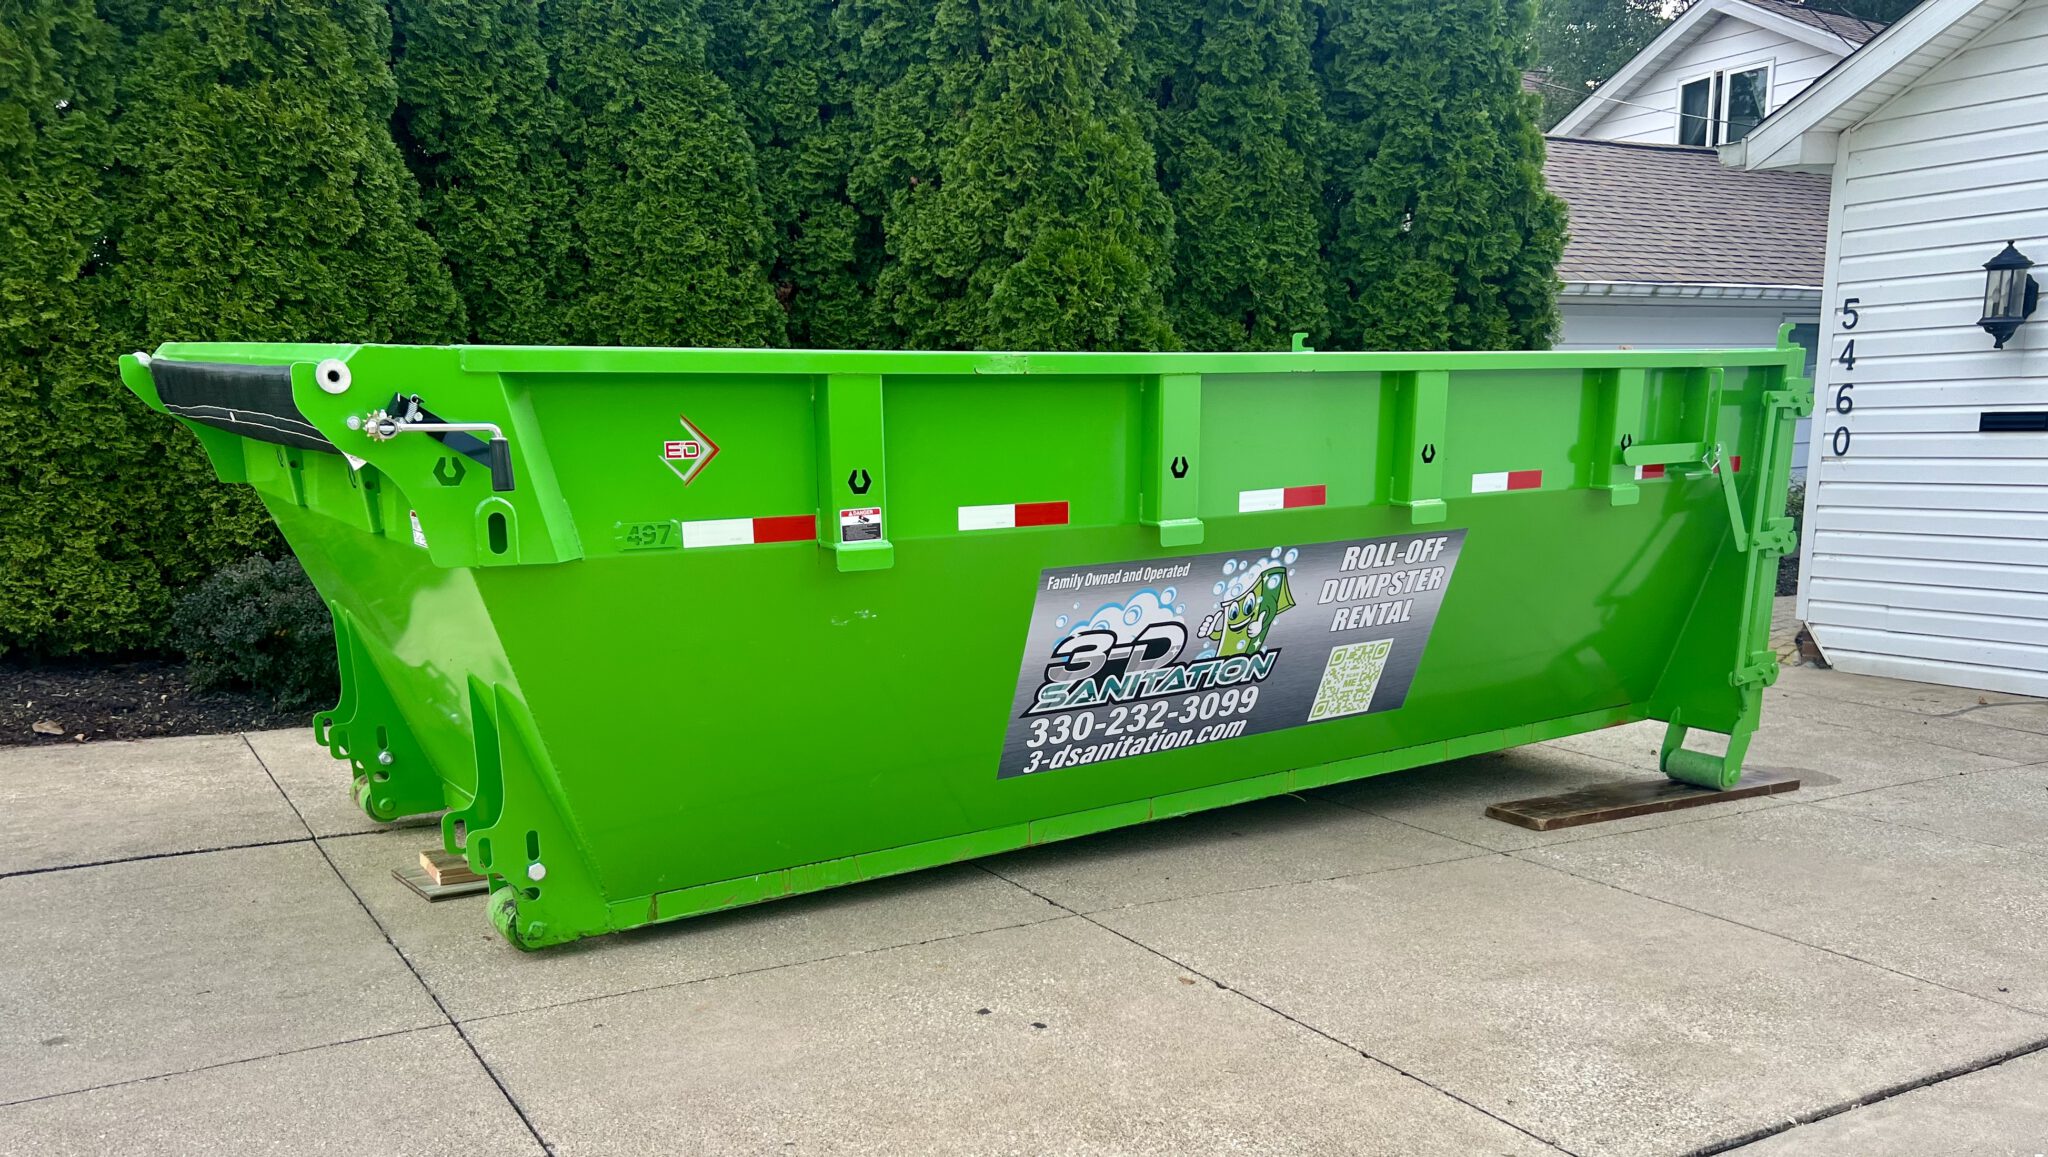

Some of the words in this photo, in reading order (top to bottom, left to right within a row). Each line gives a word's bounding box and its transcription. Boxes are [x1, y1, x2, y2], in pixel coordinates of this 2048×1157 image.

[626, 524, 672, 546] 497
[1339, 536, 1448, 572] ROLL-OFF
[1046, 574, 1084, 591] Family
[1085, 572, 1120, 587] Owned
[1122, 568, 1141, 583] and
[1143, 563, 1191, 583] Operated
[1317, 566, 1446, 605] DUMPSTER
[1329, 598, 1415, 632] RENTAL
[1047, 624, 1186, 683] 3-D
[1028, 651, 1278, 713] SANITATION
[1343, 678, 1357, 688] ME
[1026, 685, 1260, 748] 330-232-3099
[1022, 719, 1248, 774] 3-dsanitation.com
